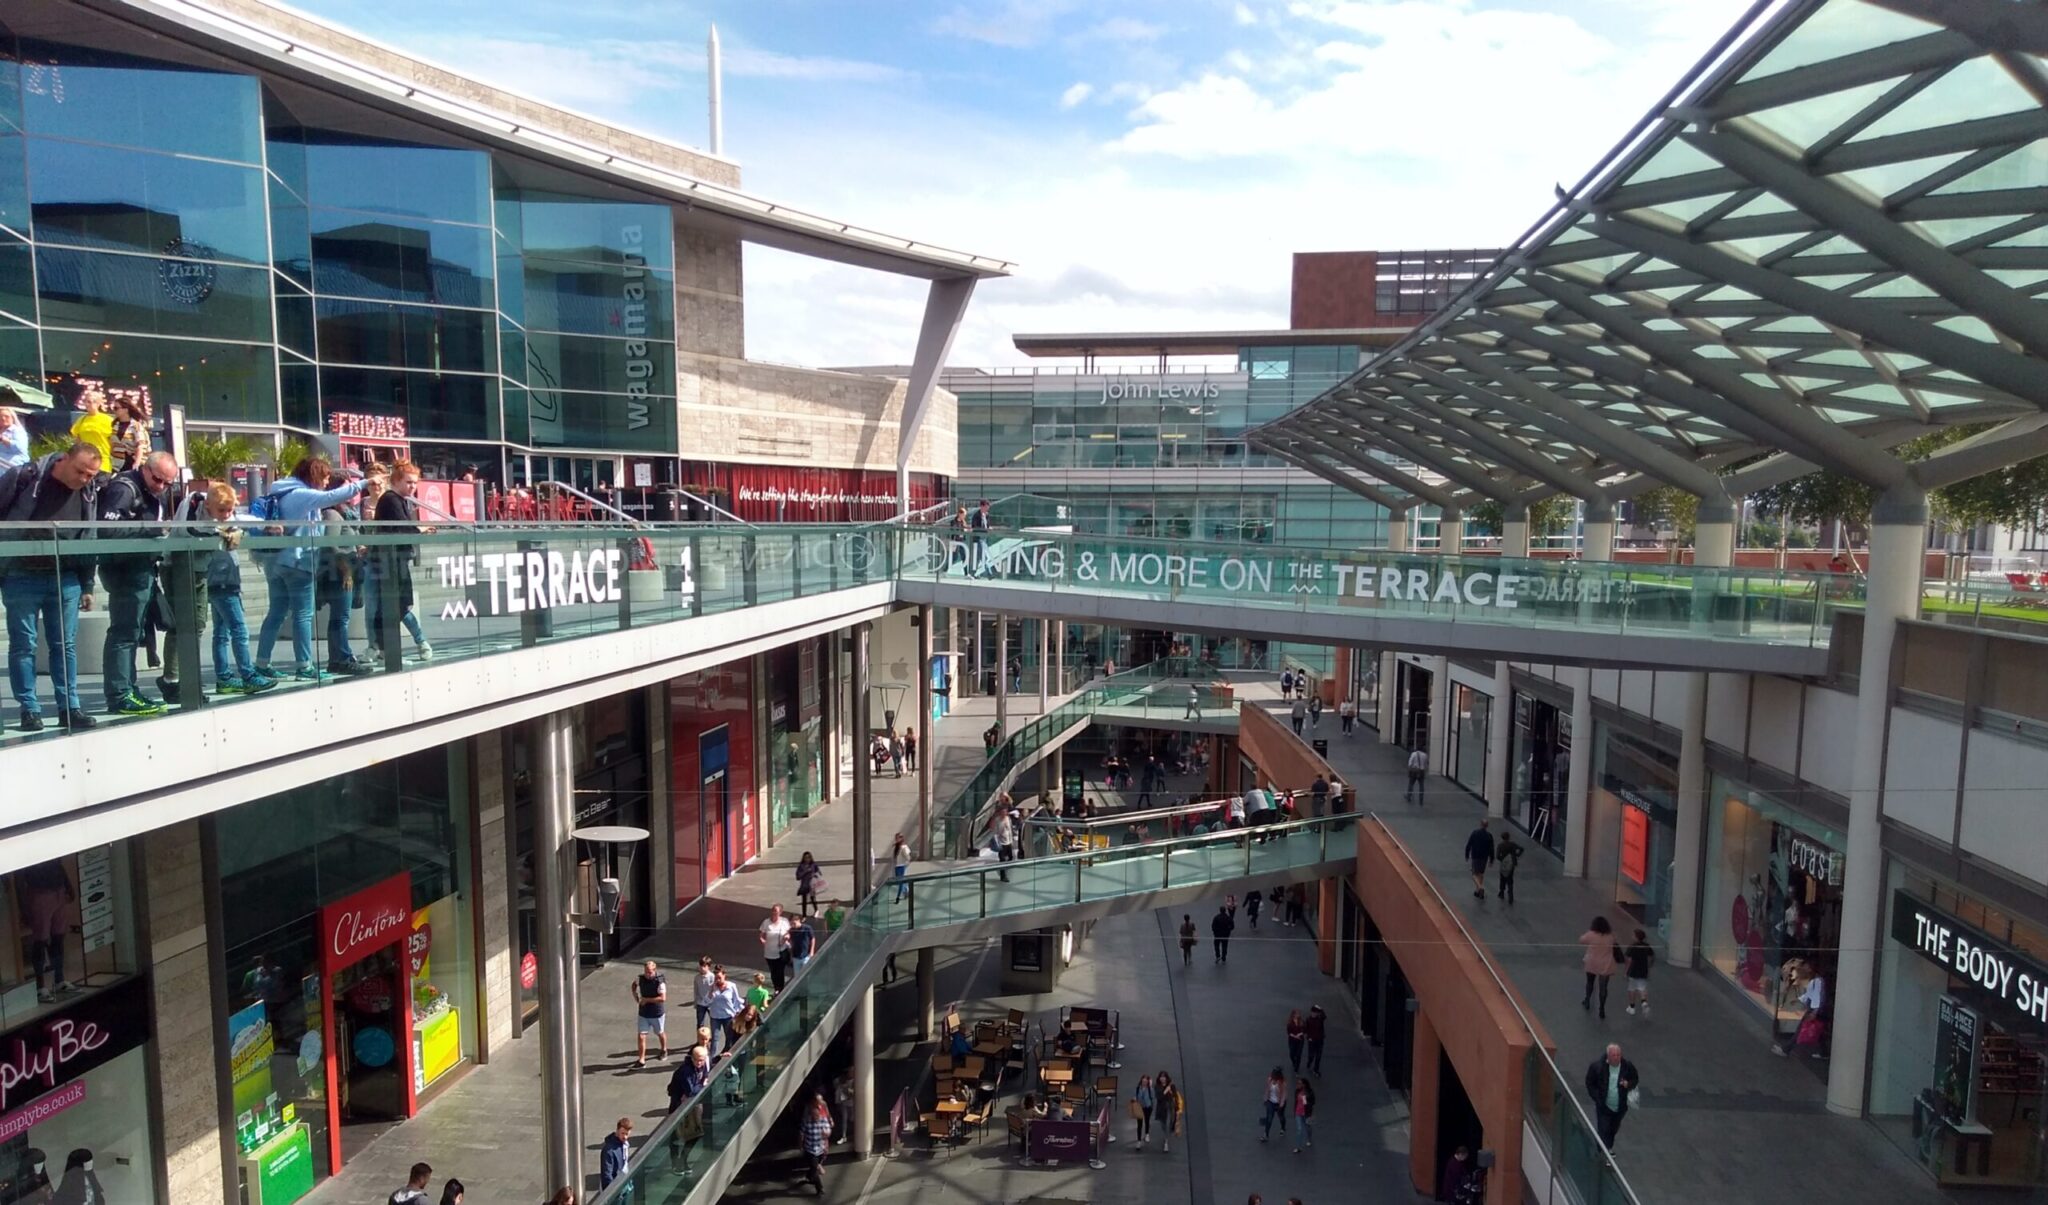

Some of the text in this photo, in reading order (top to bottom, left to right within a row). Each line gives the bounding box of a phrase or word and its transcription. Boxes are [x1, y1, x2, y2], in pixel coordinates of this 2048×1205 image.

[622, 224, 655, 430] wagamama
[1100, 378, 1219, 405] John Lewis
[437, 555, 477, 588] THE
[482, 549, 622, 615] TERRACE
[948, 540, 1520, 608] DINING & MORE ON THE TERRACE
[334, 908, 406, 955] Clintons
[1915, 913, 2048, 1023] THE BODY SH
